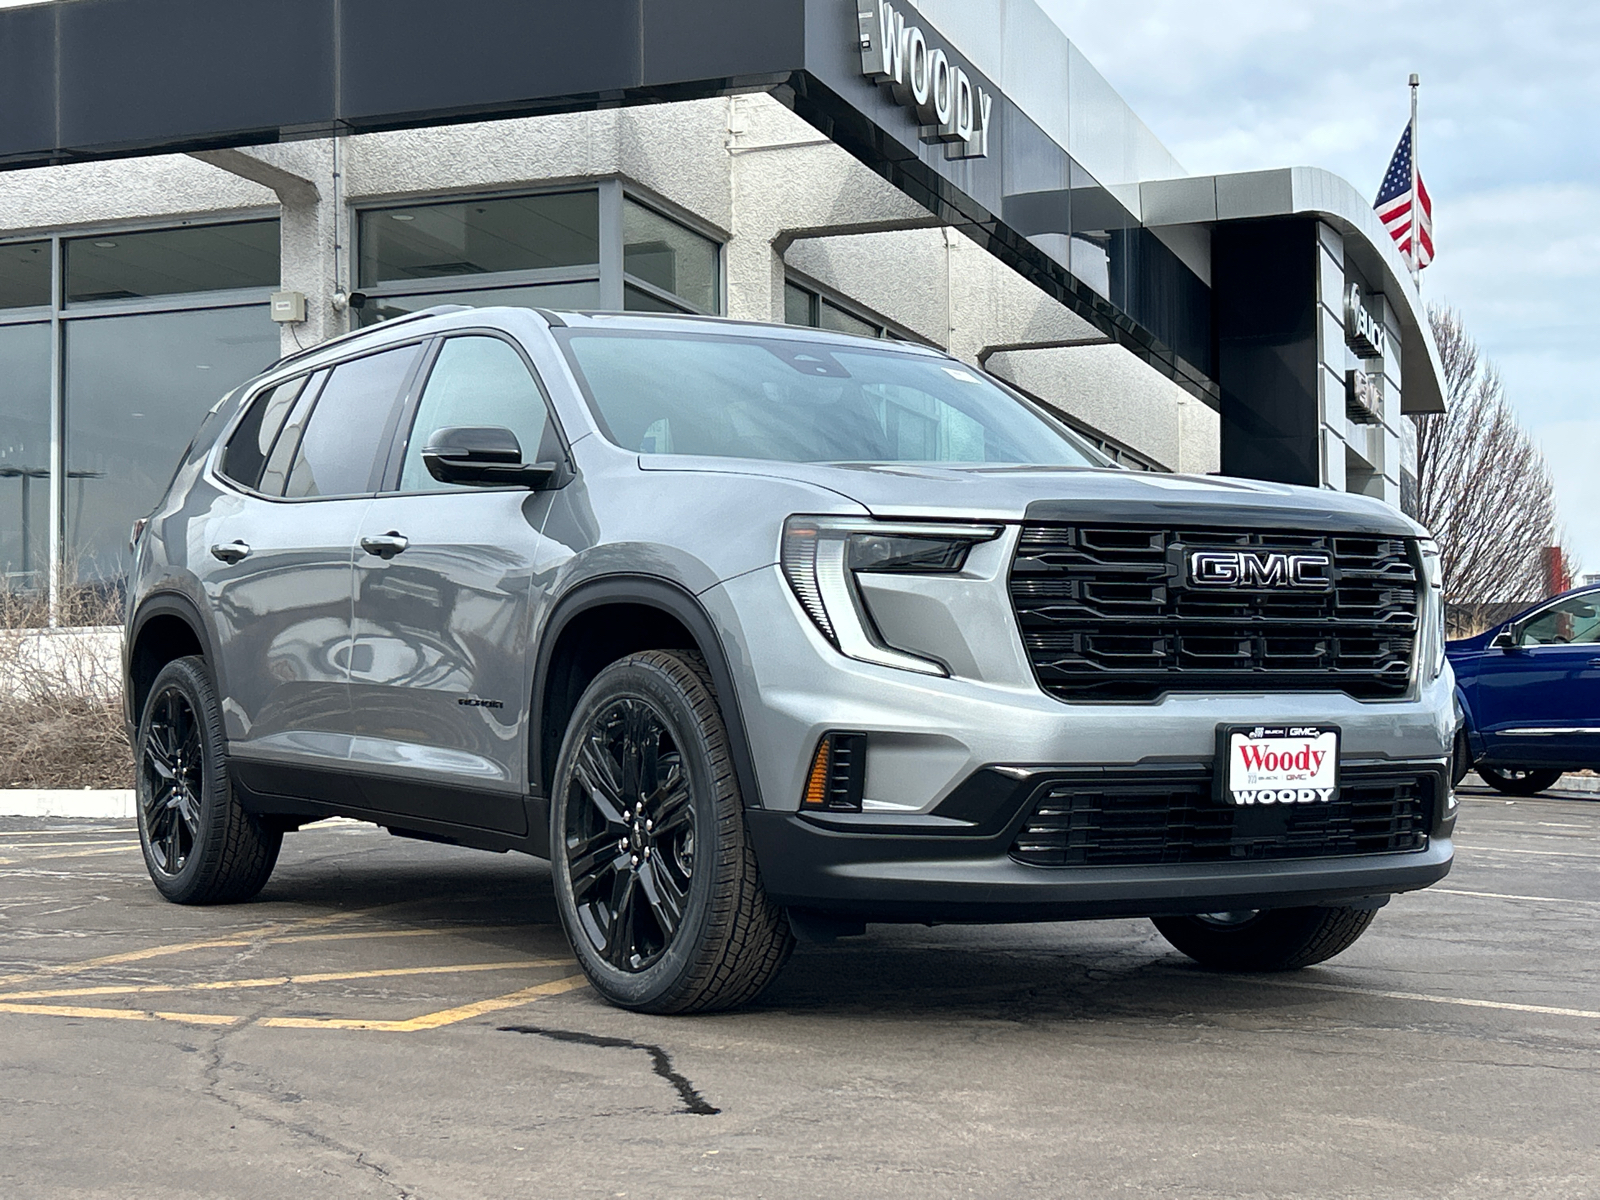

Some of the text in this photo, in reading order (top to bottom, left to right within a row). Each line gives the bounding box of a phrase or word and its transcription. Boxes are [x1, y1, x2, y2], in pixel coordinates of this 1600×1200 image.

[876, 0, 992, 158] WOODY
[1191, 552, 1330, 587] GMC
[1289, 727, 1317, 736] GMC
[1238, 744, 1327, 777] Woody
[1233, 788, 1334, 805] WOODY
